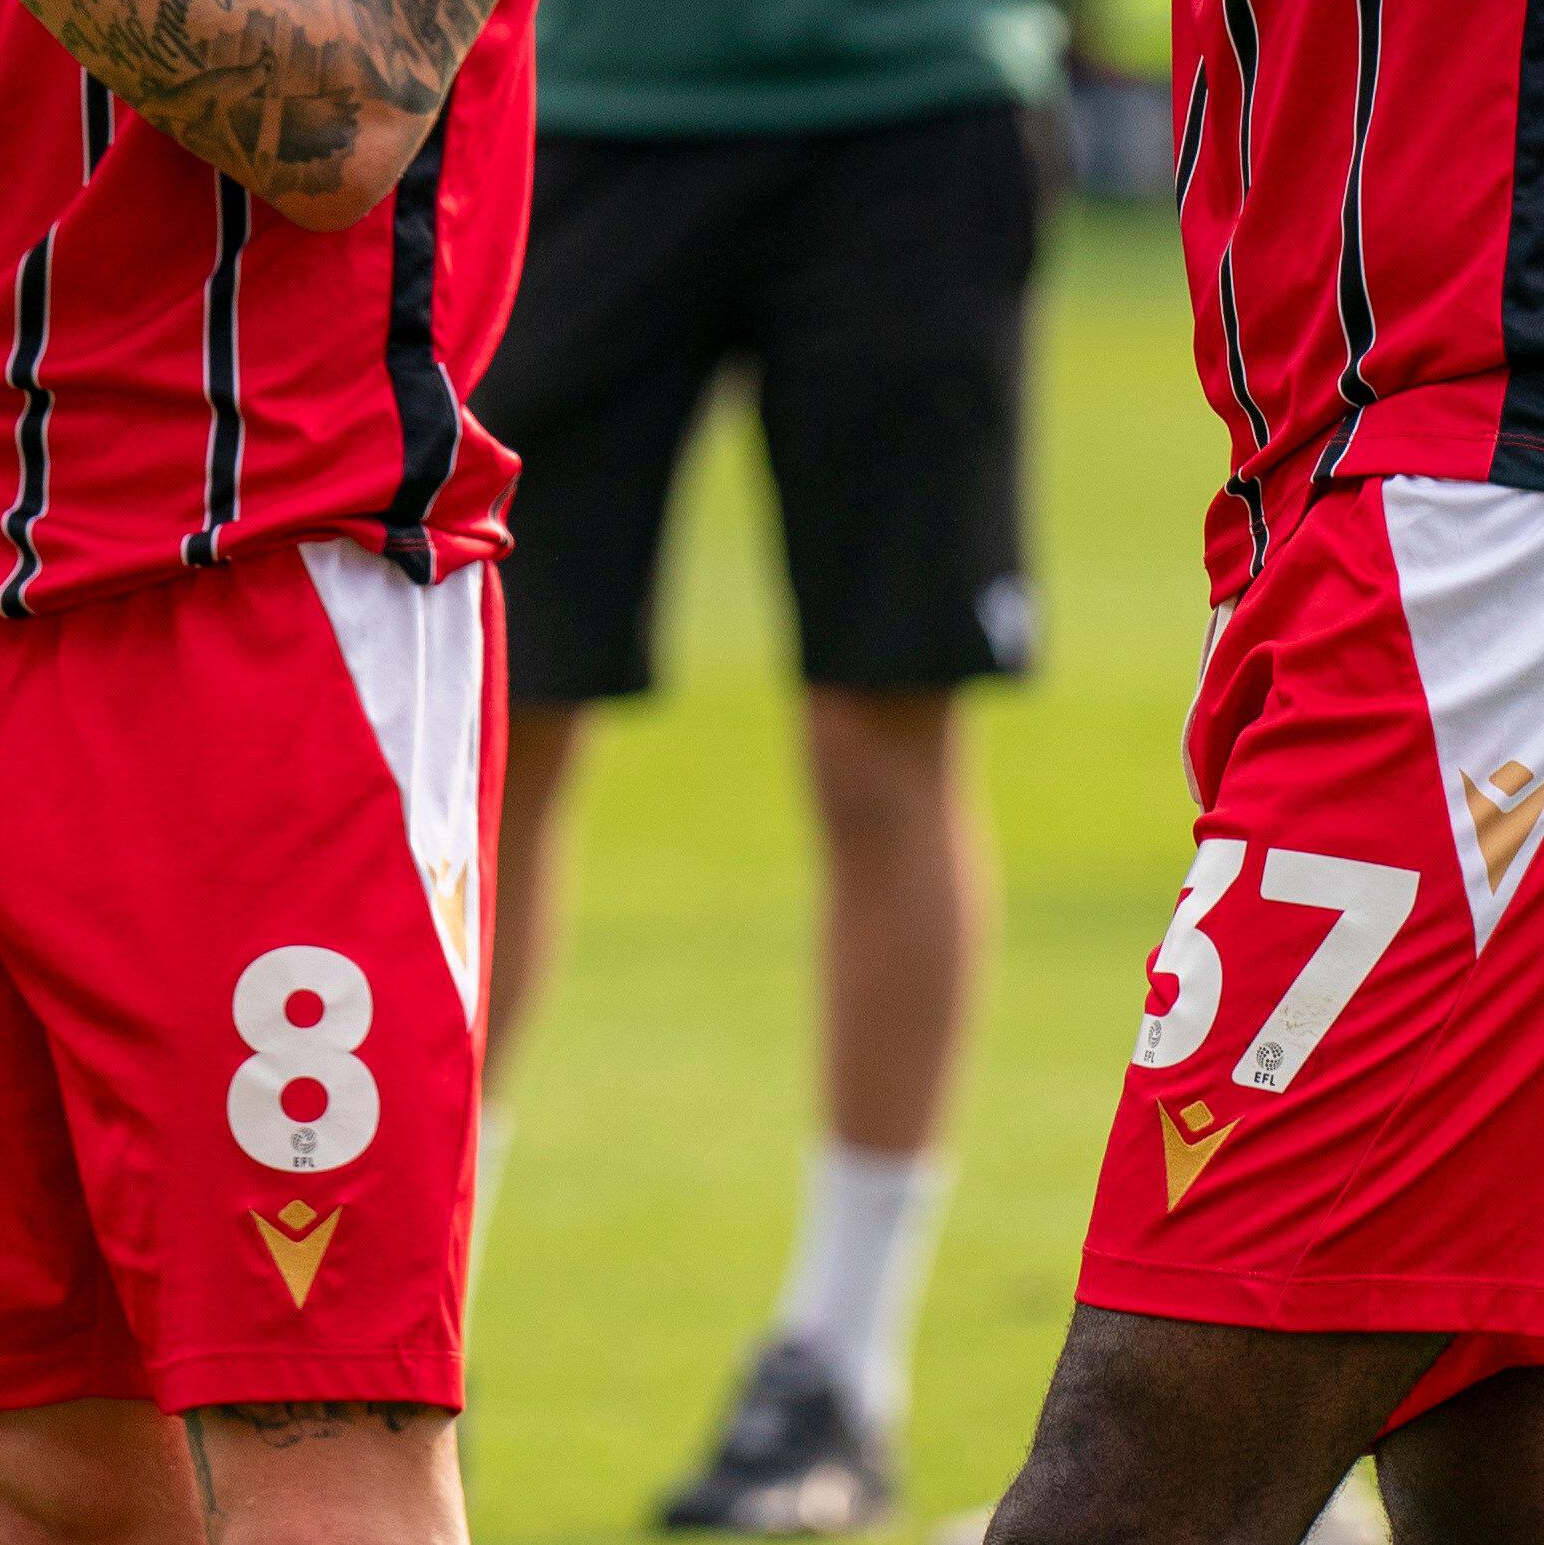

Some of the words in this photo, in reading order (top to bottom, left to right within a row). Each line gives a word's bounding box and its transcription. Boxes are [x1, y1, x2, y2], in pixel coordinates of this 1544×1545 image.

[1131, 837, 1421, 1095] 37
[226, 944, 381, 1174] 8
[1253, 1070, 1276, 1087] EFL
[292, 1156, 315, 1168] EFL
